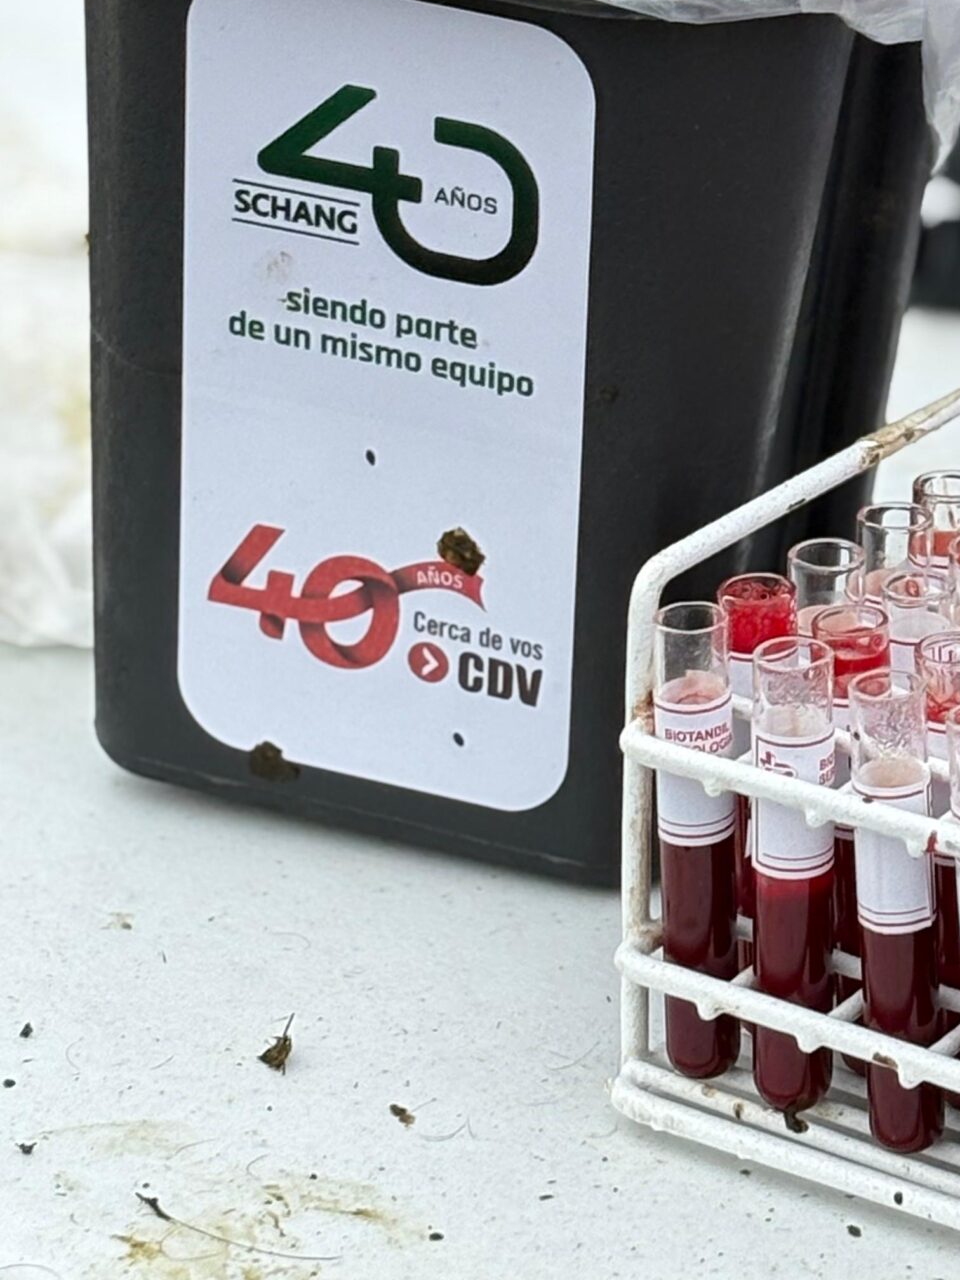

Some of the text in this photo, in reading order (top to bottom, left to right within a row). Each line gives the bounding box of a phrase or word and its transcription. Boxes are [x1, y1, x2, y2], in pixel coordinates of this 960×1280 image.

[234, 189, 358, 235] SCHANG
[257, 84, 541, 286] 40
[434, 187, 498, 215] AÑOS
[285, 288, 478, 349] siendo parte
[229, 310, 534, 397] de un mismo equipo
[207, 523, 400, 670] 40
[416, 566, 464, 589] AÑOS
[413, 611, 543, 661] Cerca de vos
[458, 651, 543, 708] CDV
